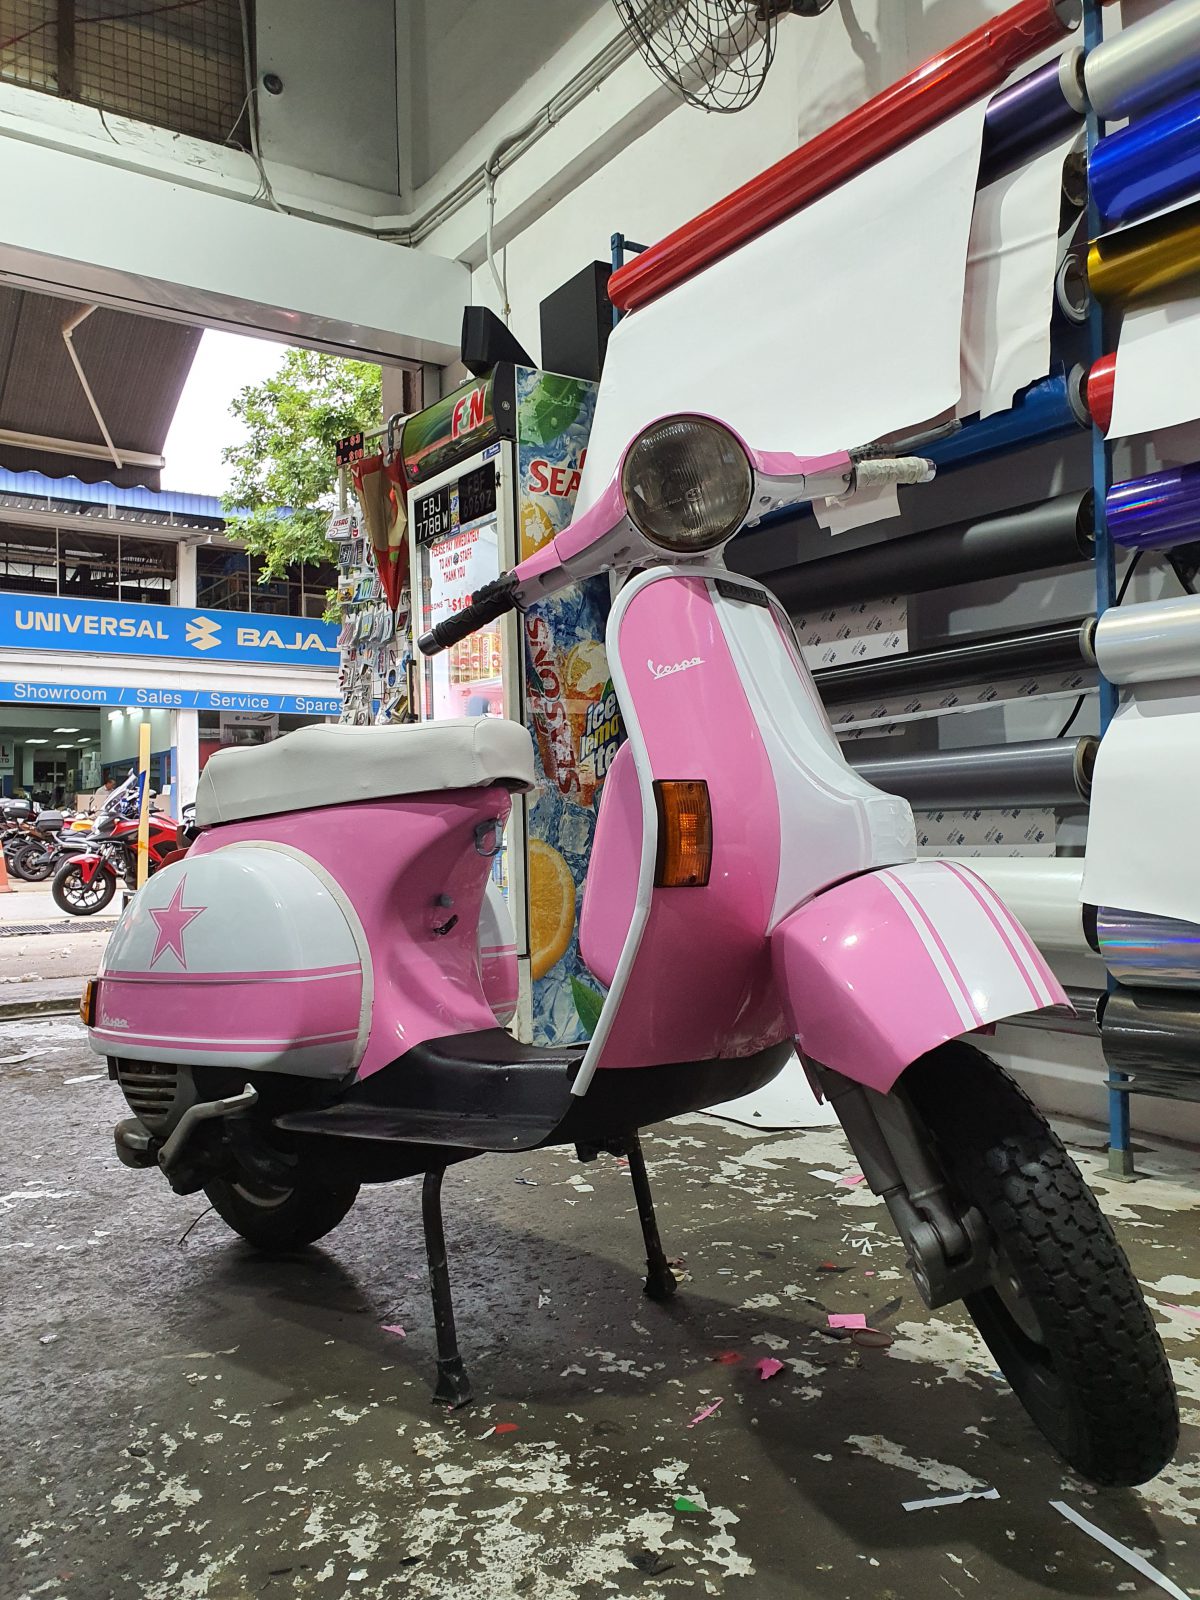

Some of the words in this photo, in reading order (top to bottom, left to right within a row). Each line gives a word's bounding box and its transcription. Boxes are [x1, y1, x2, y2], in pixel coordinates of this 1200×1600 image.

[452, 383, 488, 440] F&N
[528, 459, 581, 497] SEA
[422, 493, 441, 519] FBJ
[443, 569, 457, 583] THANK
[457, 566, 465, 579] YOU
[15, 609, 170, 640] UNIVERSAL
[647, 656, 706, 680] Vespa
[14, 683, 107, 701] Showroom
[136, 688, 182, 705] Sales
[209, 692, 270, 708] Service
[586, 692, 617, 737] ice
[102, 1003, 130, 1029] Vespa
